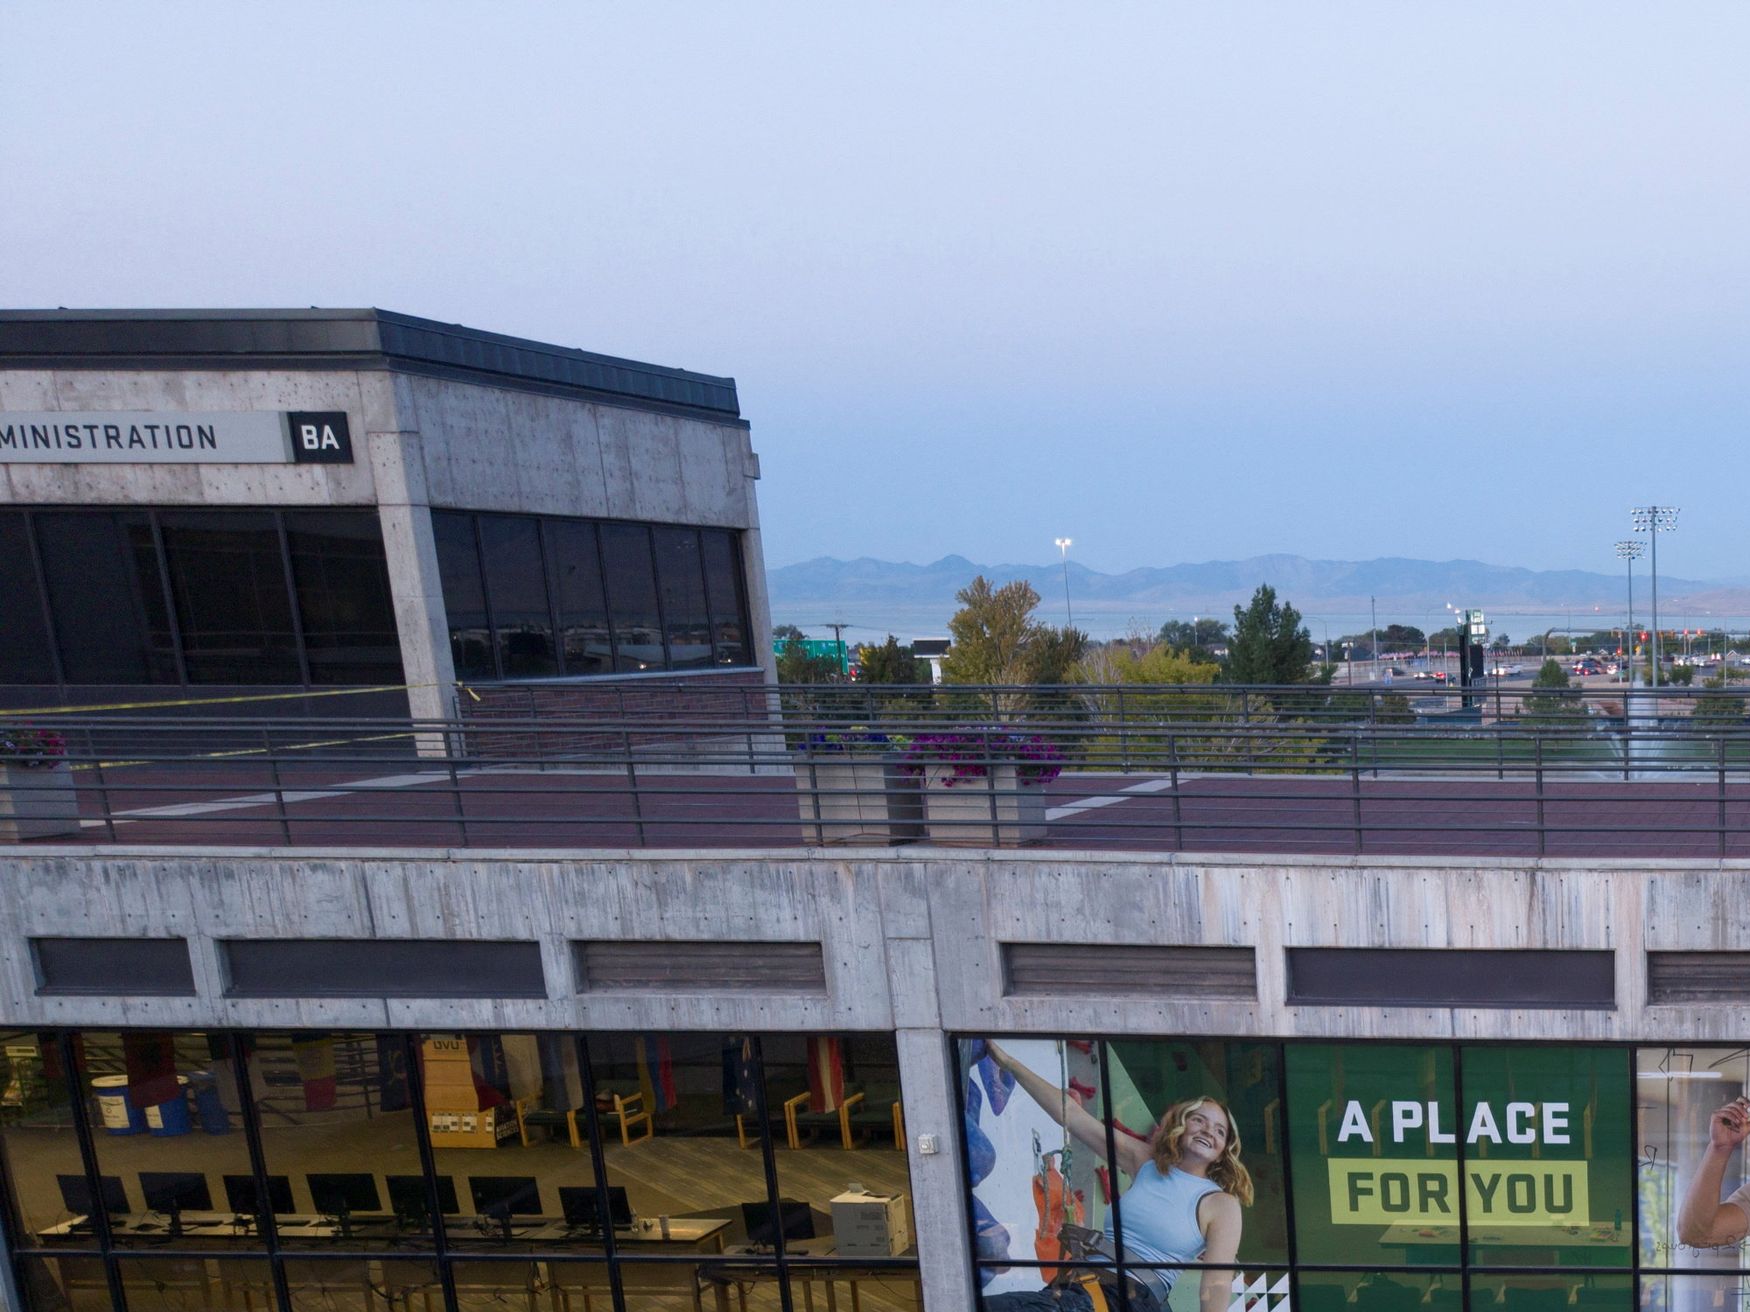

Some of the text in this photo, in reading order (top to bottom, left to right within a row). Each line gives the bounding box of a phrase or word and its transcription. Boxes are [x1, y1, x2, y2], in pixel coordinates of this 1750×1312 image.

[301, 425, 340, 450] BA
[1338, 1100, 1570, 1144] A PLACE
[1347, 1172, 1573, 1214] FOR YOU
